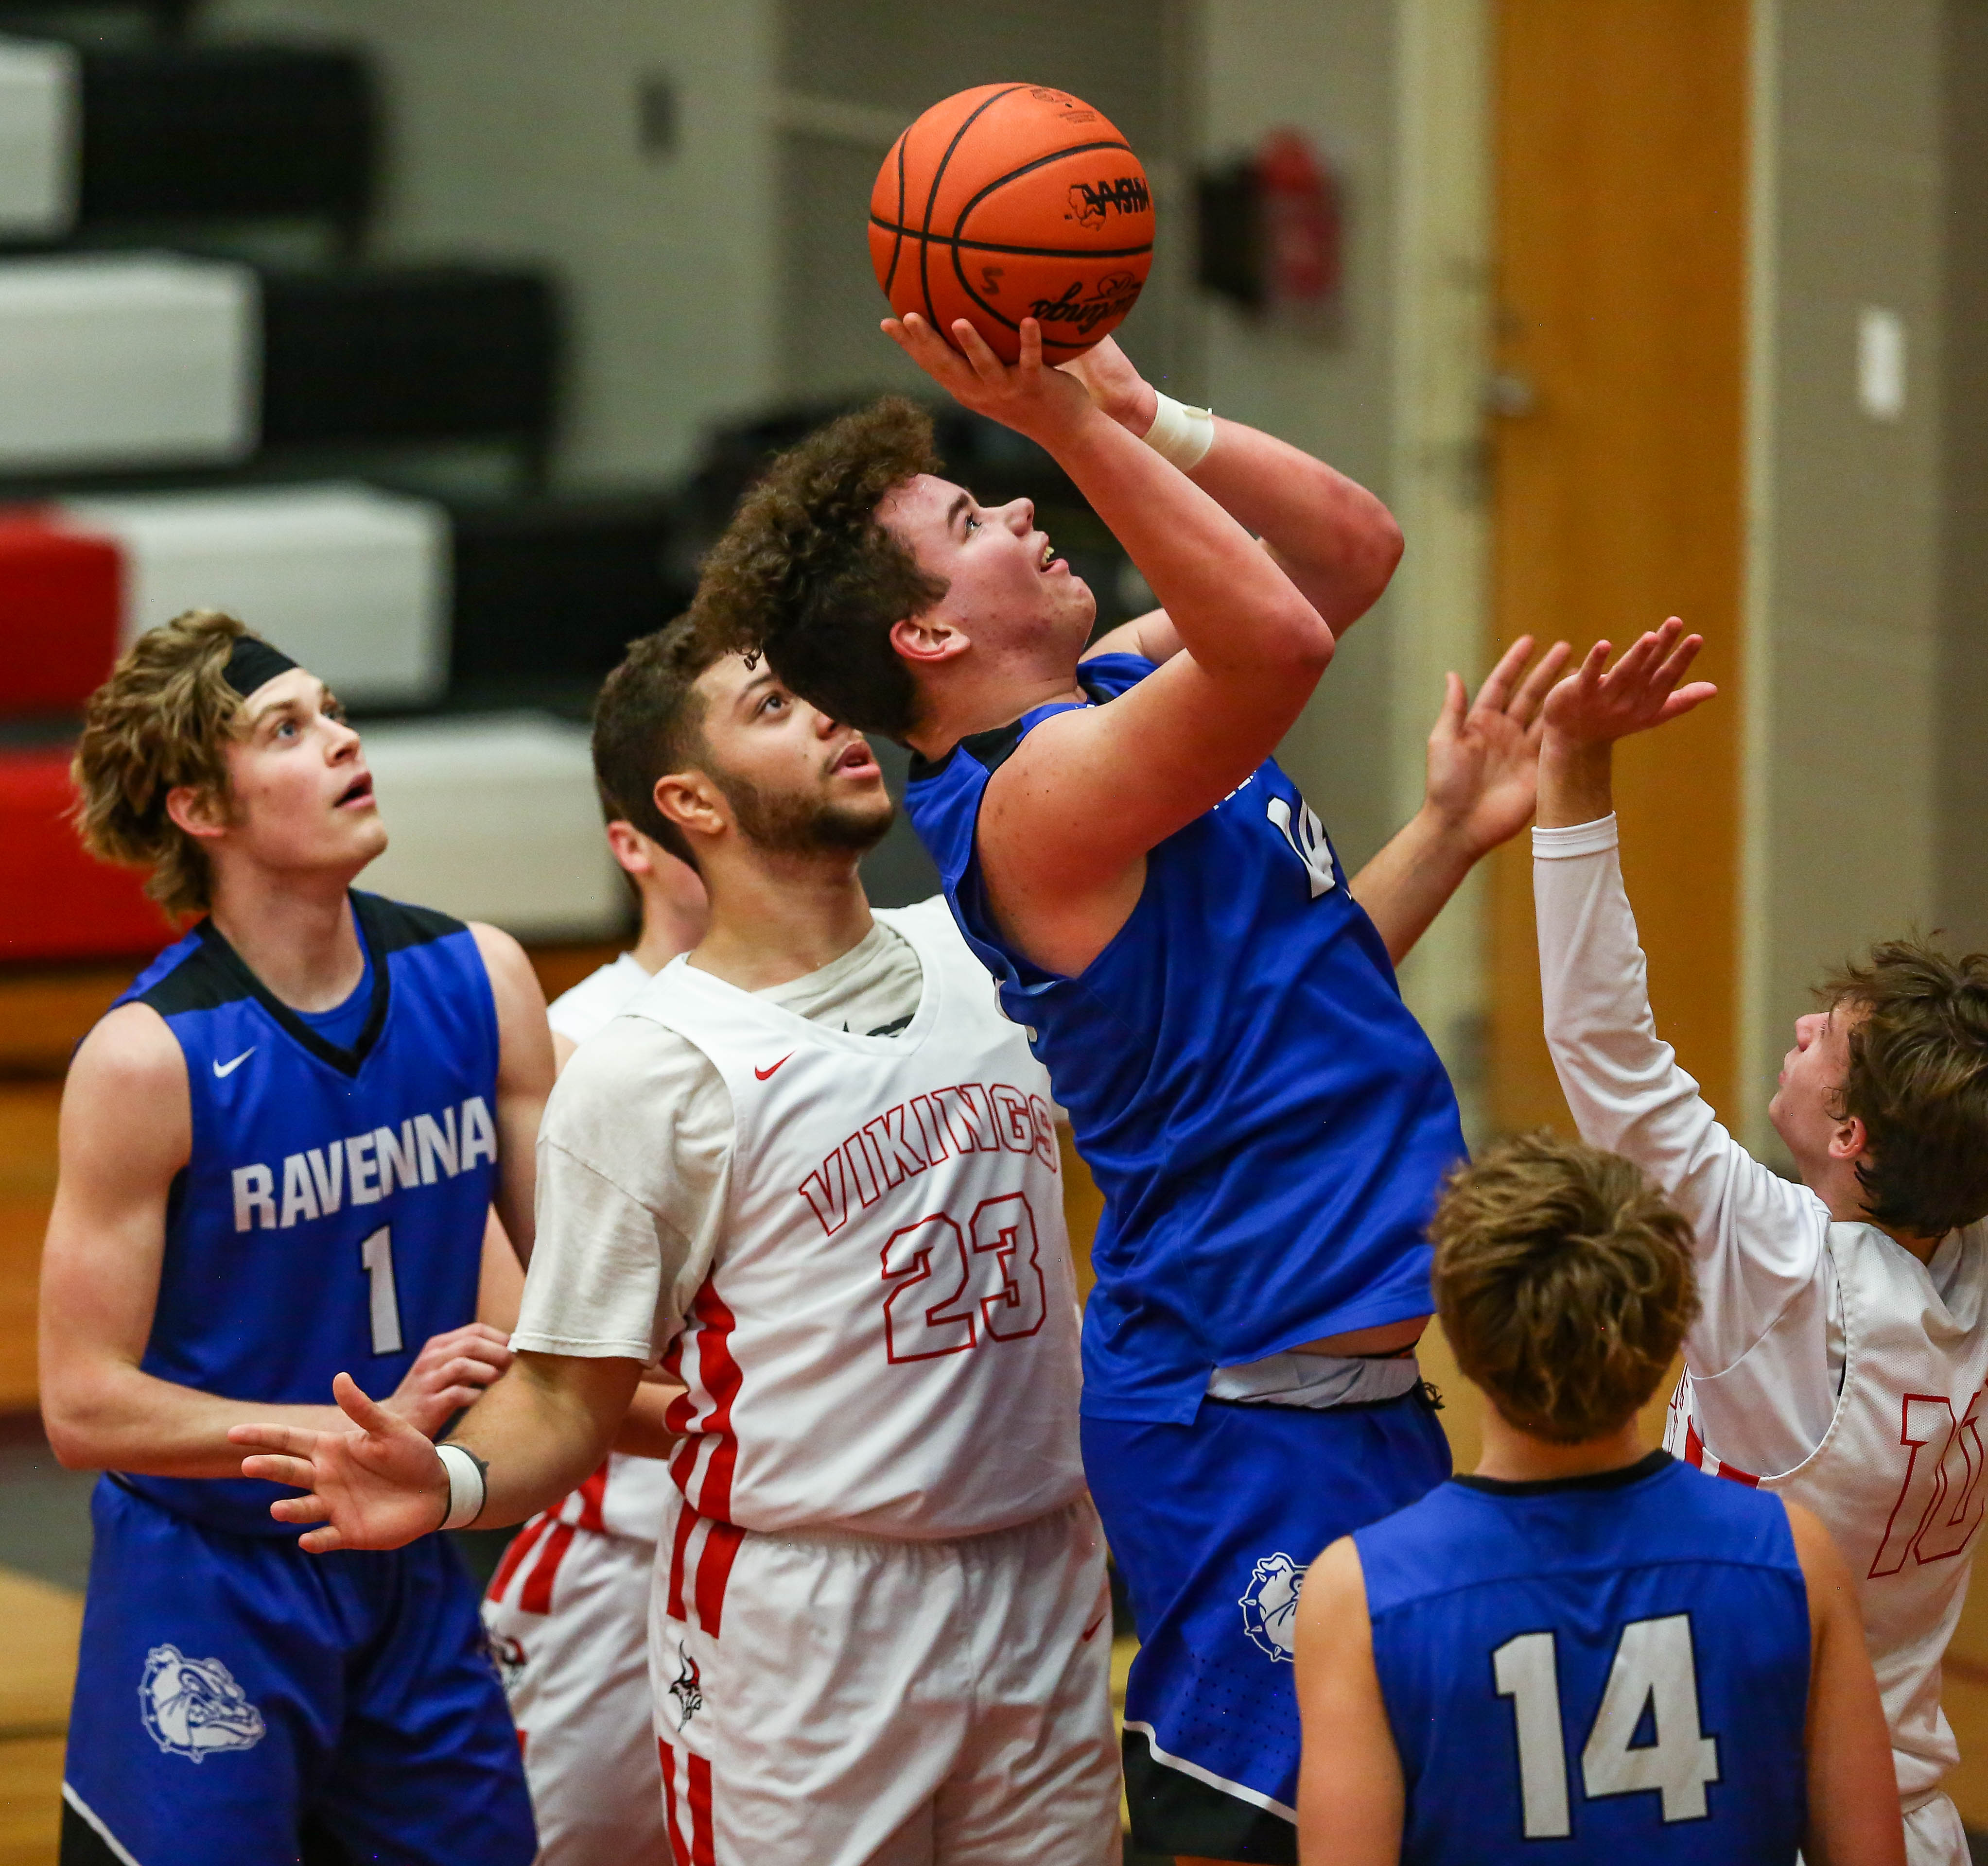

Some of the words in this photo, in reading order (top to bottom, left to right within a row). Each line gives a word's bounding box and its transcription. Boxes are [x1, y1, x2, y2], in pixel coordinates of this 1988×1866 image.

[230, 1096, 498, 1233] RAVENNA
[798, 1083, 1057, 1237] VIKINGS
[361, 1223, 403, 1356] 1
[881, 1191, 1047, 1365] 23
[1492, 1612, 1721, 1840] 14
